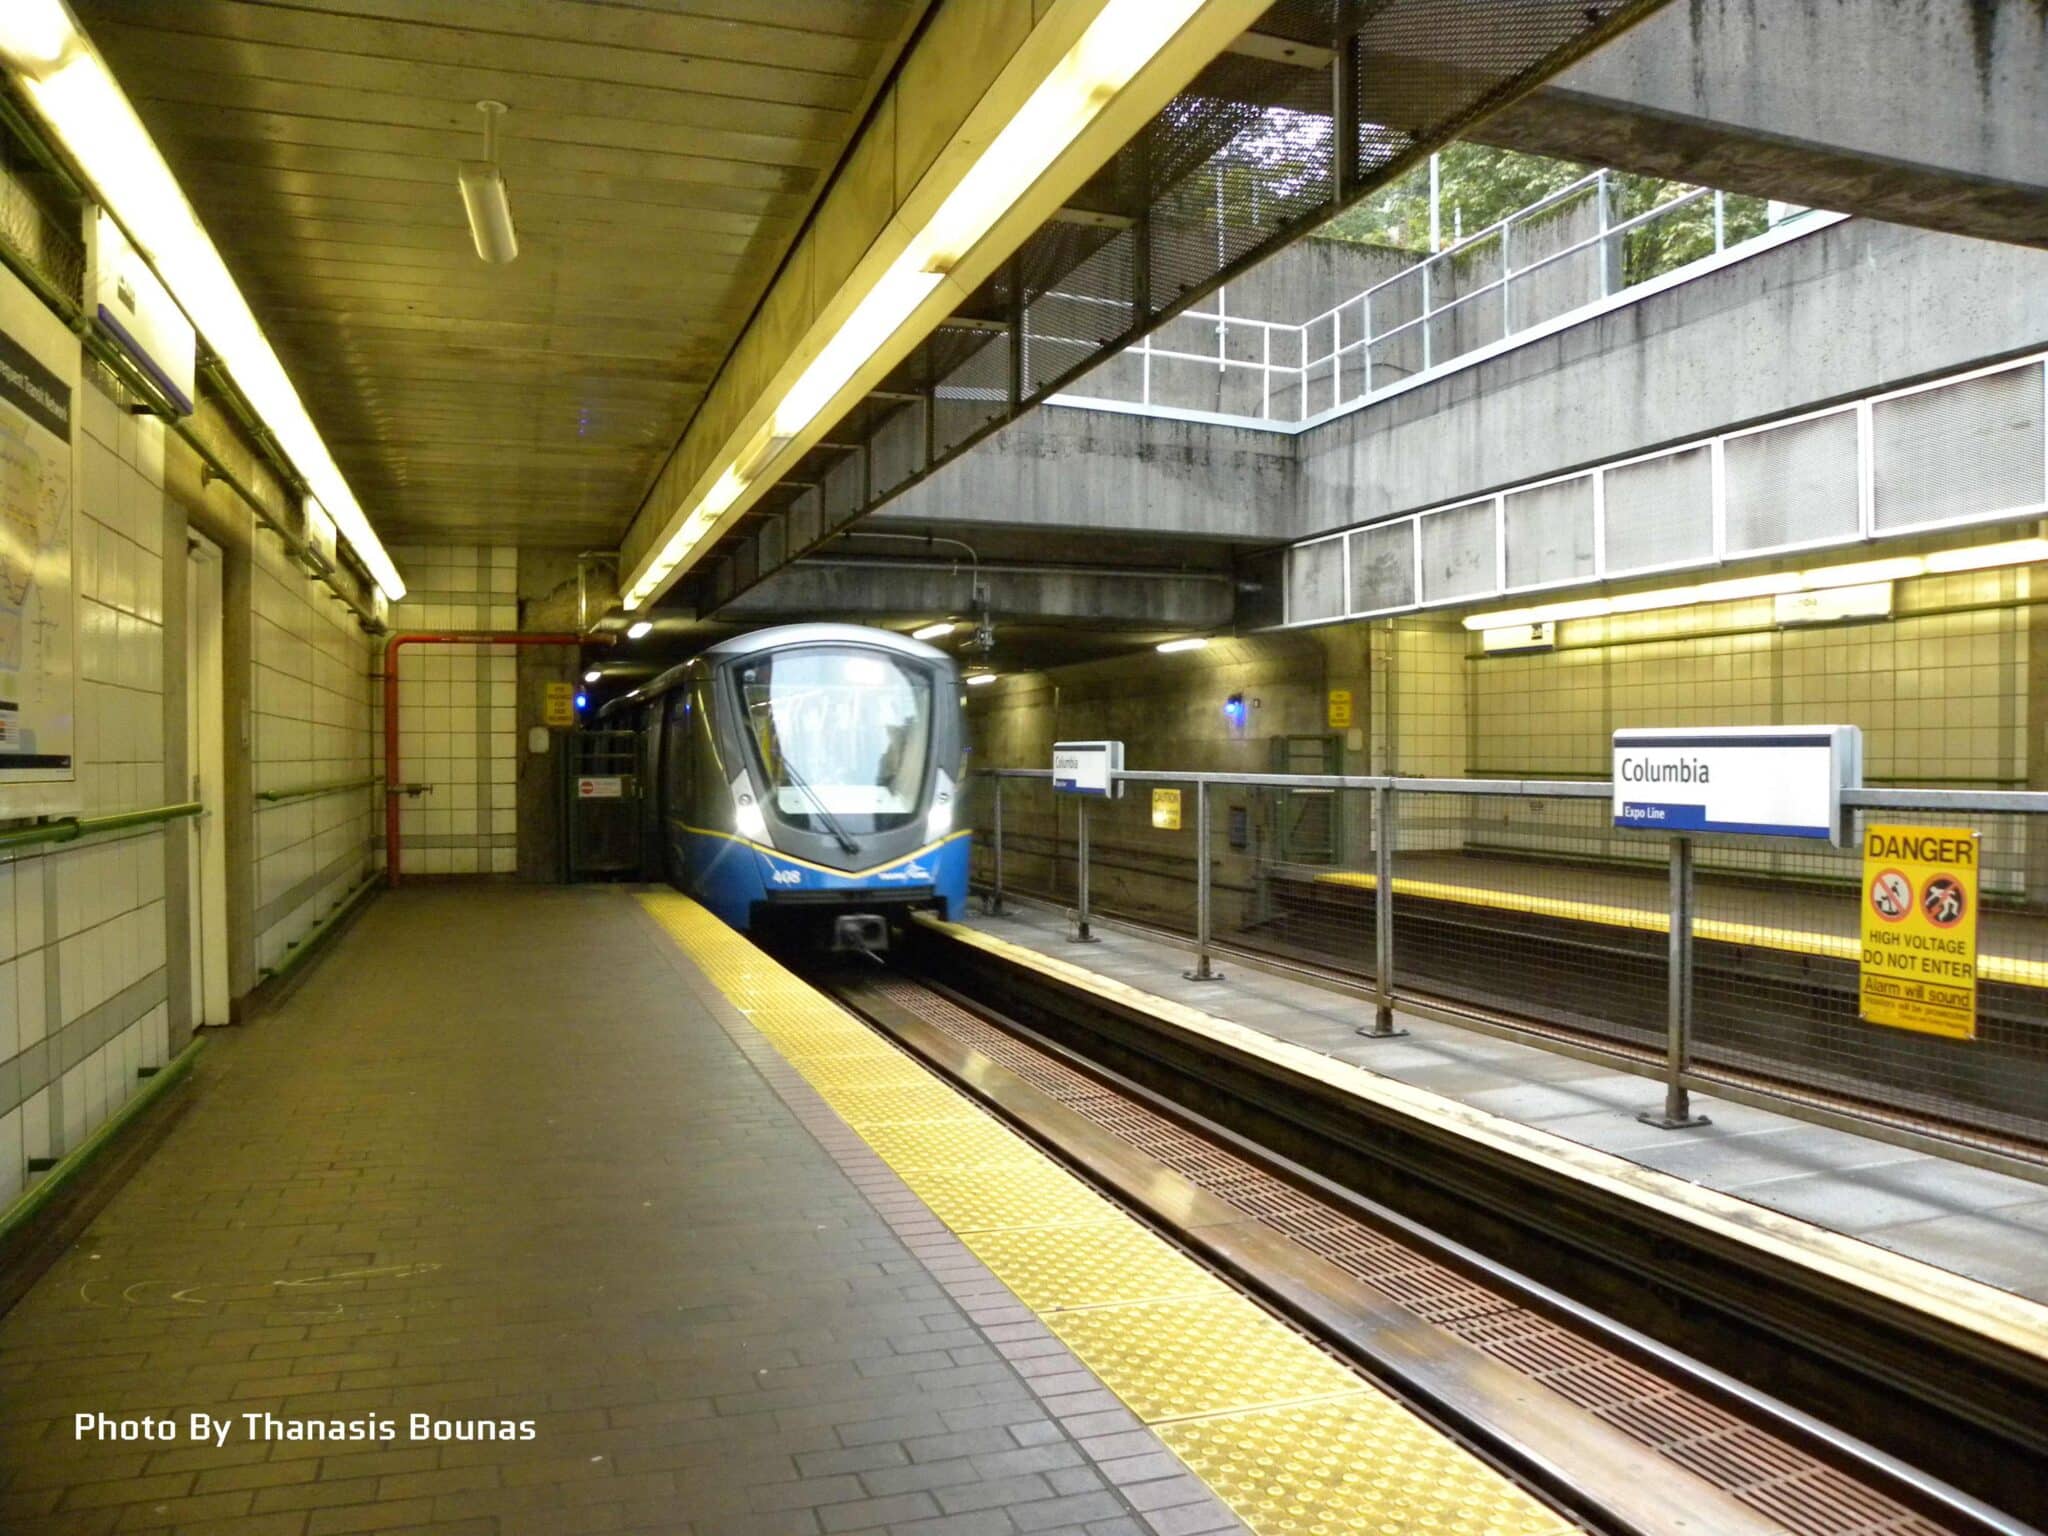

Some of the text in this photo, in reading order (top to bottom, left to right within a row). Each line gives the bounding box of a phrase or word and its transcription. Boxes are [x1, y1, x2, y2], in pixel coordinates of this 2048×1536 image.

[1056, 755, 1078, 770] Columbia
[1620, 756, 1710, 783] Columbia
[1624, 806, 1666, 820] Expo Line
[1869, 834, 1974, 864] DANGER
[1869, 929, 1967, 956] HIGH VOLTAGE
[1863, 948, 1973, 979] DO NOT ENTER
[1864, 976, 1970, 1007] Alarm will sound
